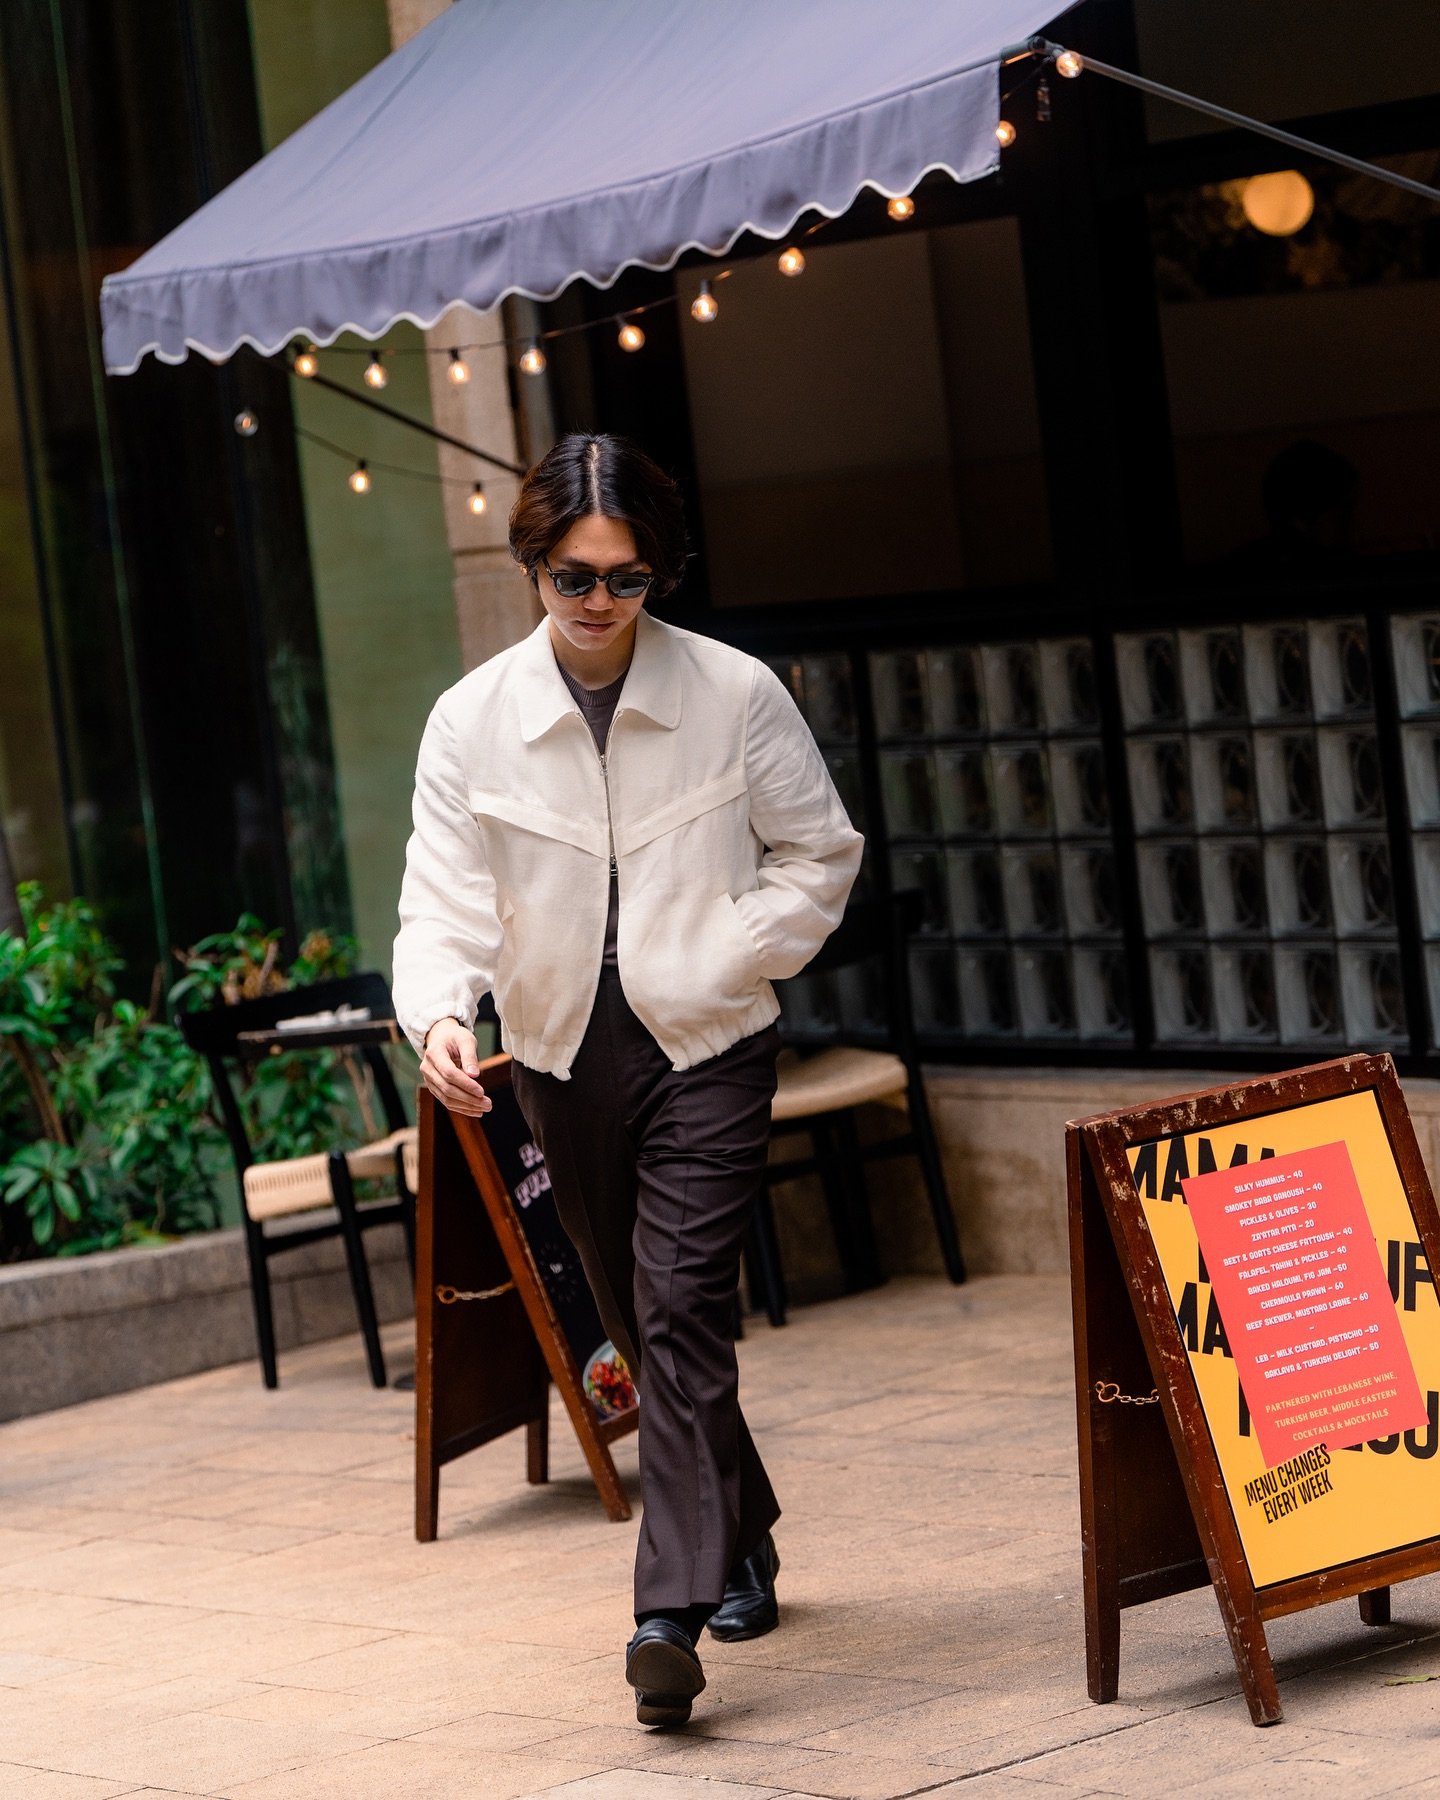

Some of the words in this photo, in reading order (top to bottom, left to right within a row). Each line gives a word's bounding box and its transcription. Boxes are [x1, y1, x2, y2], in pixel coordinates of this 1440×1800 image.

[1224, 1199, 1252, 1213] SMOKEY
[1253, 1195, 1272, 1206] BABA
[1273, 1187, 1305, 1201] GANOUSH
[1312, 1182, 1323, 1191] 40
[1234, 1182, 1253, 1193] SILKY
[1255, 1174, 1286, 1188] HUMMUS
[1293, 1170, 1303, 1178] 40
[1239, 1213, 1268, 1227] PICKLES
[1268, 1212, 1274, 1220] &
[1275, 1205, 1299, 1218] OLIVES
[1306, 1201, 1317, 1210] 30
[1280, 1223, 1297, 1234] PITA
[1304, 1219, 1314, 1228] 20
[1223, 1255, 1241, 1266] BEET
[1242, 1253, 1248, 1261] &
[1249, 1247, 1272, 1260] GOATS
[1272, 1240, 1299, 1254] CHEESE
[1299, 1231, 1335, 1247] FATTOUSH
[1342, 1226, 1353, 1235] 40
[1270, 1259, 1293, 1271] TAHINI
[1294, 1257, 1300, 1266] &
[1301, 1250, 1329, 1264] PICKLES
[1337, 1245, 1347, 1254] 40
[1247, 1283, 1270, 1295] BAKED
[1303, 1271, 1316, 1281] FIG
[1317, 1267, 1332, 1277] JAM
[1260, 1292, 1301, 1309] CHERMOULA
[1301, 1285, 1327, 1299] PRAWN
[1334, 1281, 1344, 1290] 60
[1245, 1319, 1263, 1331] BEEF
[1295, 1303, 1328, 1318] MUSTARD
[1328, 1296, 1352, 1309] LABNE
[1359, 1292, 1369, 1301] 60
[1255, 1354, 1269, 1364] LEB
[1276, 1347, 1294, 1358] MILK
[1327, 1328, 1363, 1344] PISTACHIO
[1264, 1364, 1295, 1379] BAKLAVA
[1296, 1362, 1302, 1371] &
[1302, 1354, 1332, 1369] TURKISH
[1332, 1346, 1361, 1361] DELIGHT
[1369, 1341, 1379, 1351] 50
[1265, 1395, 1310, 1413] PARTNERED
[1311, 1388, 1333, 1400] WITH
[1333, 1377, 1373, 1395] LEBANESE
[1275, 1413, 1308, 1428] TURKISH
[1331, 1398, 1361, 1413] MIDDLE
[1361, 1388, 1397, 1405] EASTERN
[1293, 1423, 1335, 1441] COCKTAILS
[1337, 1421, 1343, 1429] &
[1344, 1408, 1389, 1427] MOCKTAILS
[1244, 1471, 1277, 1506] MENU
[1277, 1443, 1331, 1488] CHANGES
[1263, 1486, 1298, 1524] EVERY
[1297, 1469, 1333, 1505] WEEK
